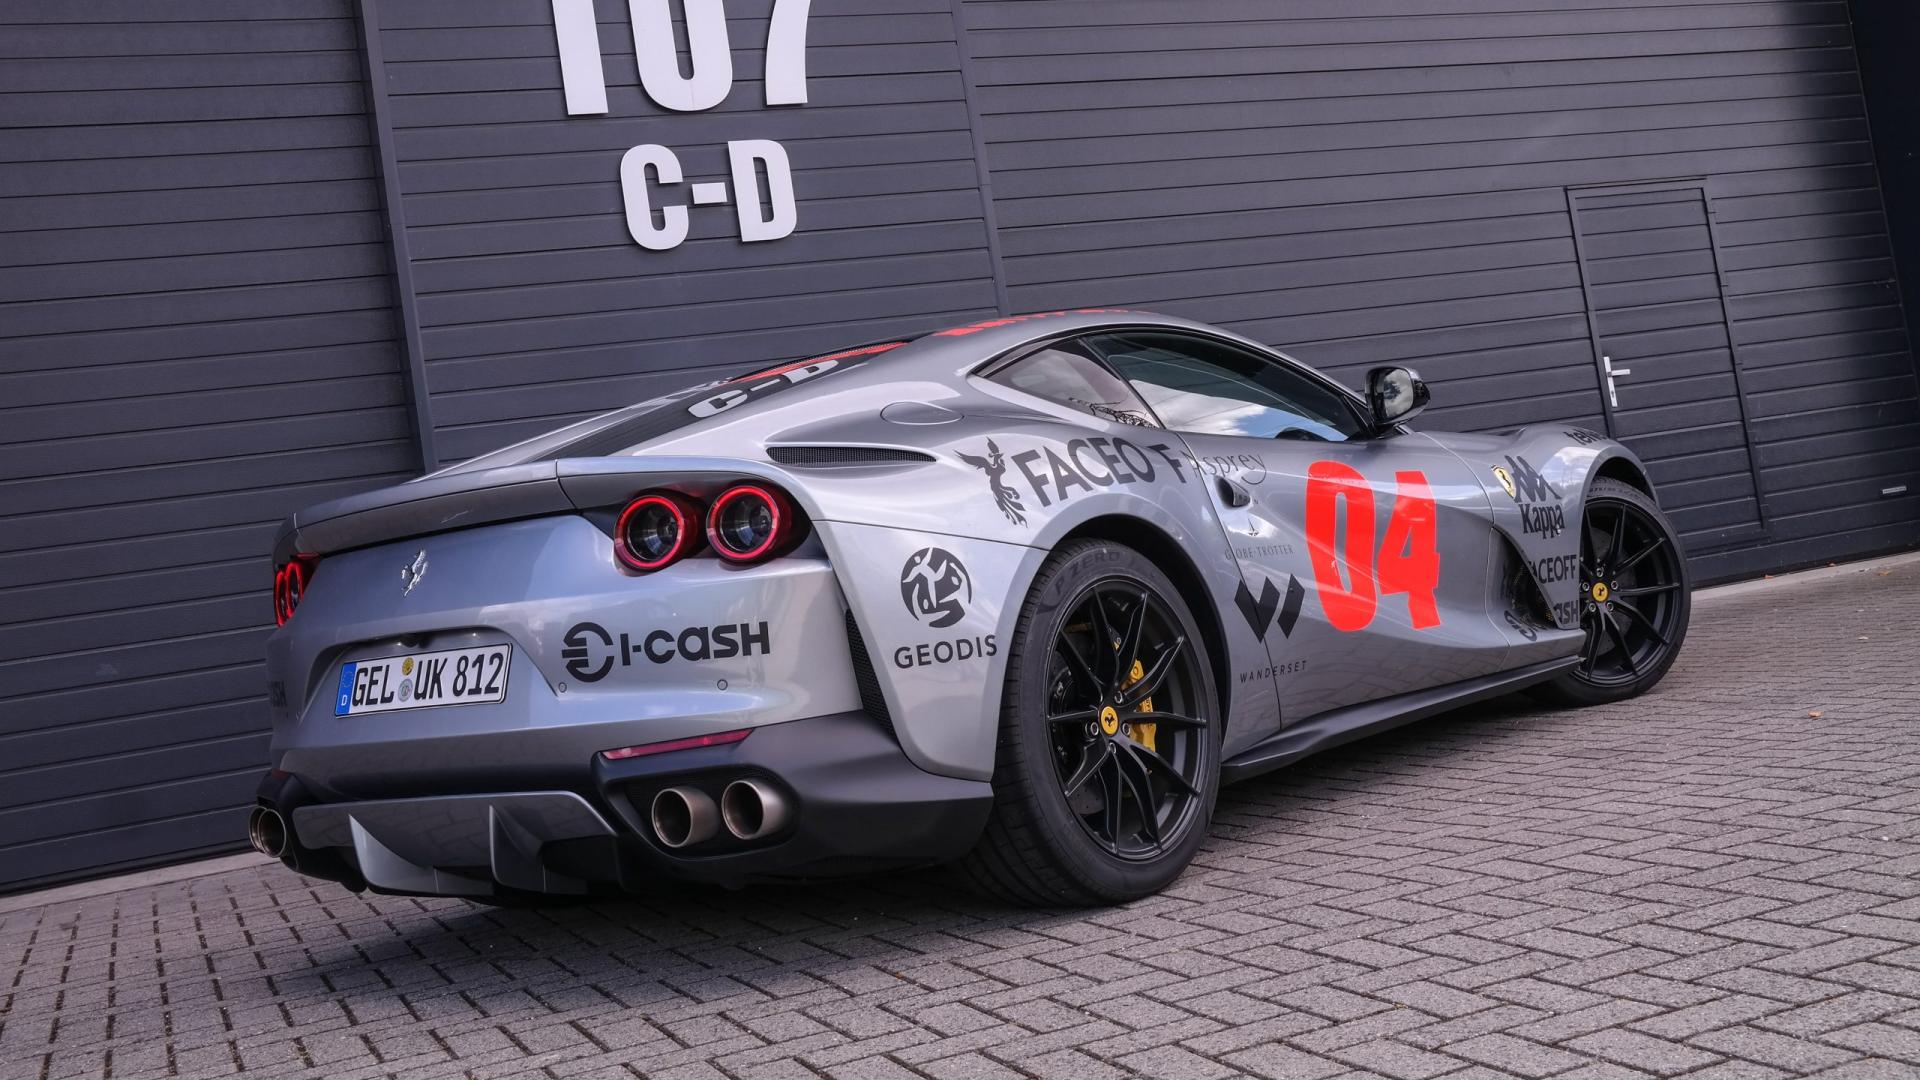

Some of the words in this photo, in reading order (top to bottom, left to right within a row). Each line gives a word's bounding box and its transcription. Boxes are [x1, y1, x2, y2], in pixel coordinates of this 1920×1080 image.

[553, 0, 811, 115] 107
[620, 139, 797, 250] C-D
[1181, 450, 1267, 485] Asprey
[1518, 503, 1565, 540] Kappa
[1071, 551, 1120, 576] ZERO
[1305, 460, 1441, 631] 04
[894, 634, 997, 669] GEODIS
[352, 664, 394, 707] GEL
[413, 657, 448, 701] UK
[453, 652, 504, 697] 812
[1240, 660, 1307, 683] WANDERSET
